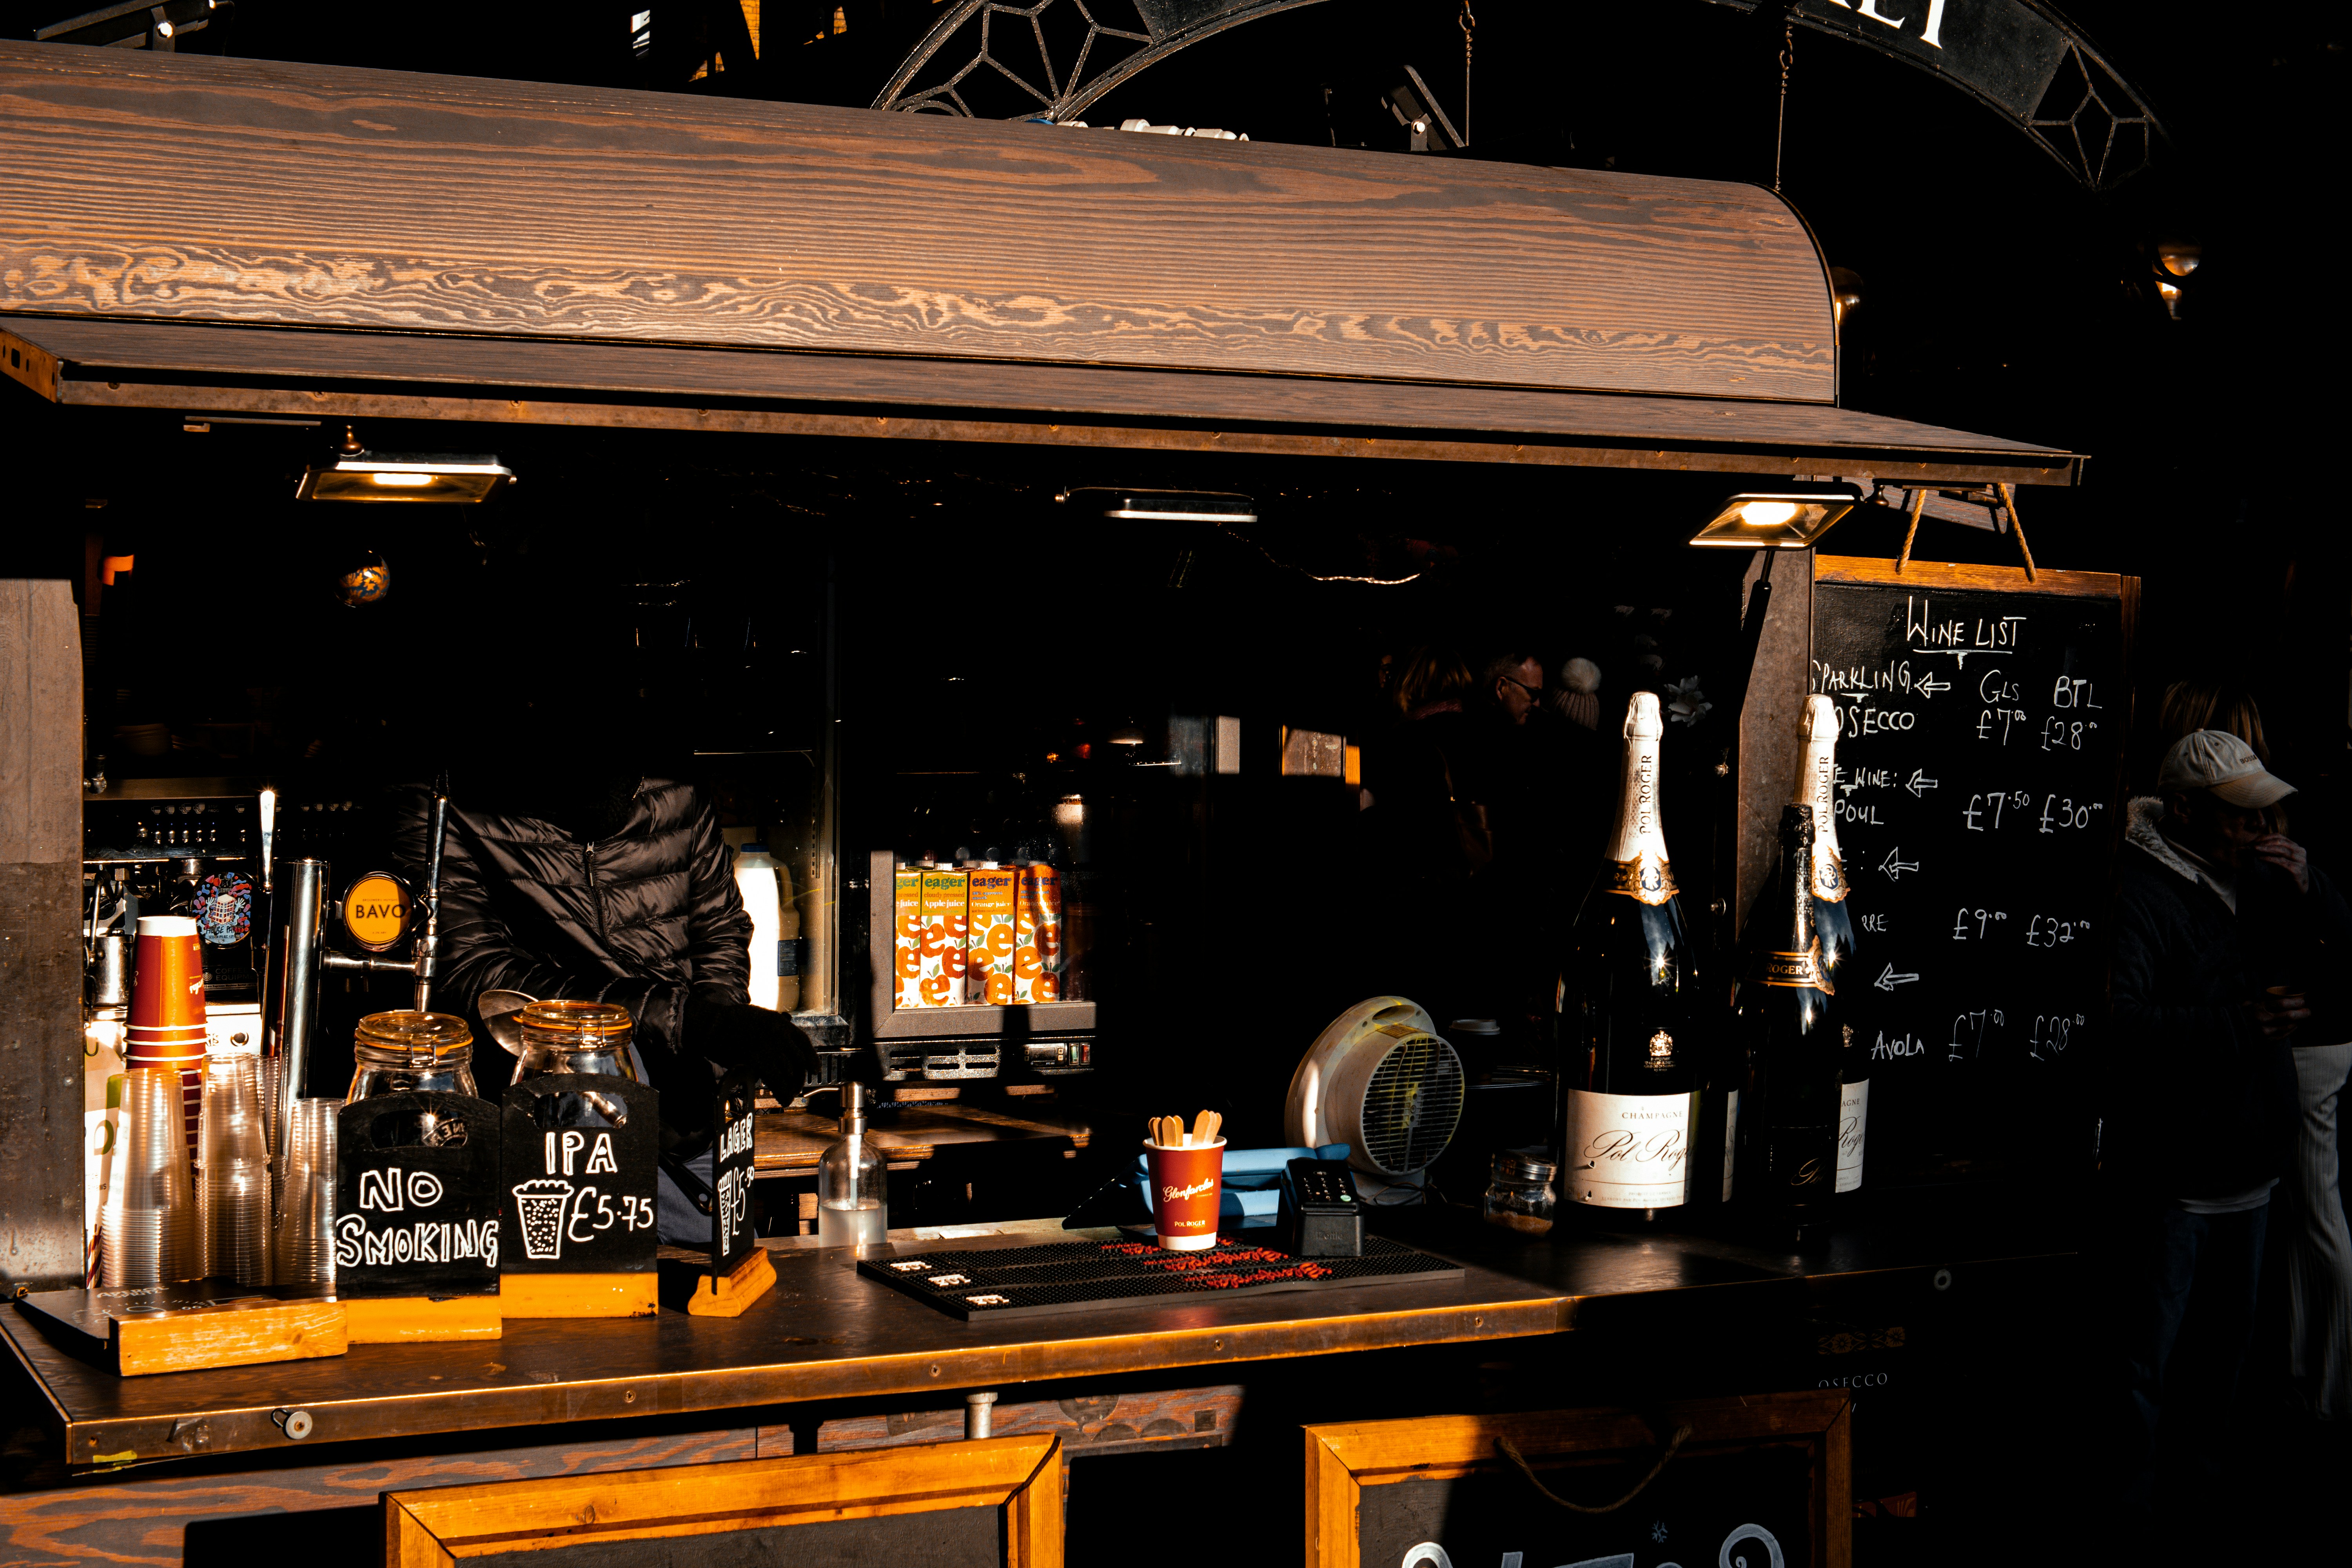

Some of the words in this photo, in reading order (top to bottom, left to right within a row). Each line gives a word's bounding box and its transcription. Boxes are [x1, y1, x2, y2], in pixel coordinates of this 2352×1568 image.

[1907, 595, 1965, 648] WINE
[1976, 617, 2027, 646] LIST
[1813, 660, 1911, 694] PARKLING
[2053, 675, 2103, 709] BTL
[1834, 706, 1915, 738] OSECCO
[1639, 755, 1651, 804] ROGER
[1817, 756, 1829, 803] ROGER
[896, 877, 919, 890] ger
[925, 877, 965, 890] eager
[972, 877, 1011, 889] eager
[1021, 877, 1058, 888] eager
[356, 904, 406, 918] BAVO
[924, 899, 946, 909] Apple
[946, 899, 965, 908] juice
[1766, 962, 1803, 975] ROGER
[1622, 1111, 1683, 1119] CHAMPAGNE
[545, 1131, 619, 1176] IPA
[720, 1112, 753, 1163] LAGER
[1584, 1129, 1641, 1161] Pol
[359, 1167, 443, 1212] NO
[336, 1213, 499, 1268] SMOKING
[1819, 1372, 1887, 1387] OSECCO
